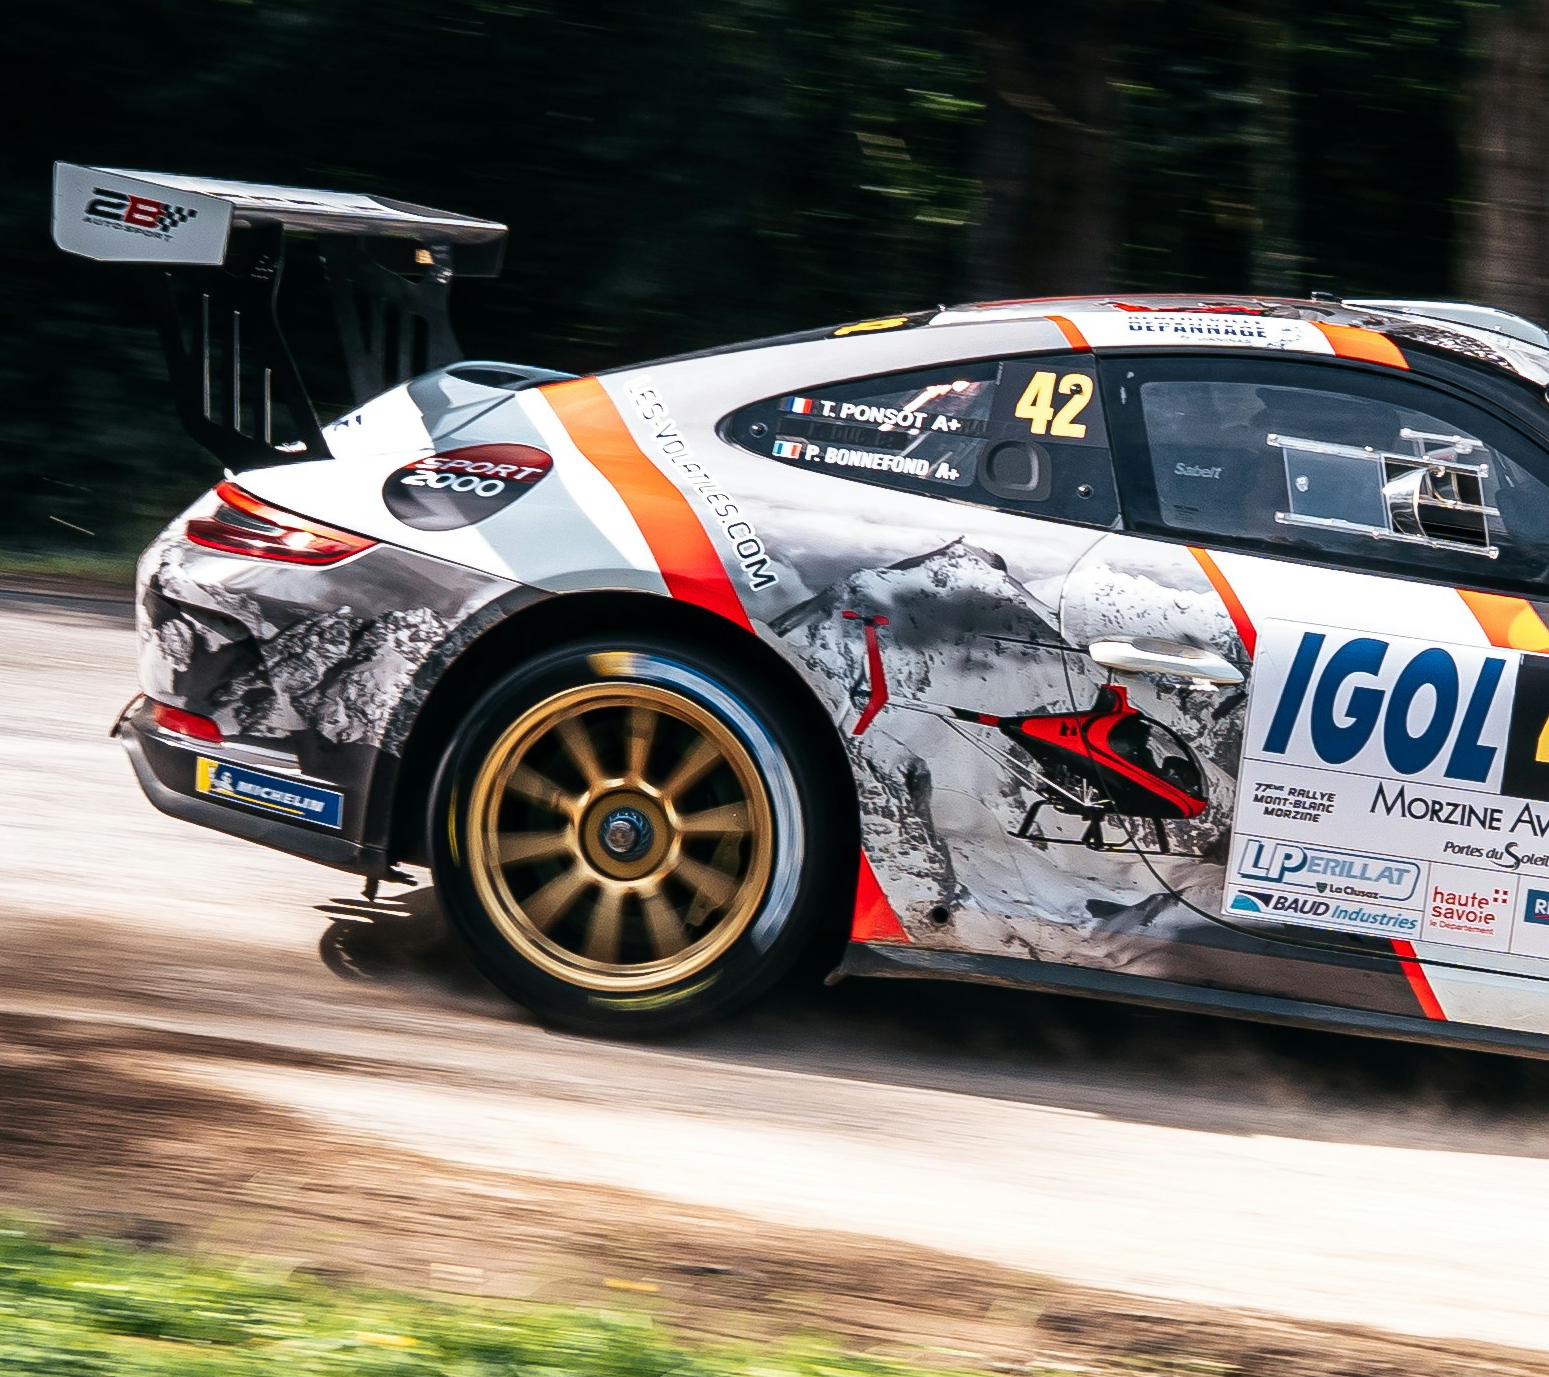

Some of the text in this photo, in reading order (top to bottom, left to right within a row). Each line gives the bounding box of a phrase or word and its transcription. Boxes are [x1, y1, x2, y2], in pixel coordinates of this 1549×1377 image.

[820, 400, 962, 431] T. PONSOT A+
[1014, 371, 1094, 439] 42
[414, 457, 544, 480] SPORT
[804, 444, 960, 480] P. BONNEFOND A+
[400, 469, 506, 498] 2000
[1262, 631, 1507, 783] IGOL
[235, 780, 326, 813] MICHELIN
[1252, 793, 1335, 814] MONT-BLANC
[1287, 787, 1336, 803] RALLYE
[1369, 781, 1504, 832] MORZINE
[1262, 806, 1322, 823] MORZINE
[1442, 840, 1485, 858] Portes
[1485, 847, 1504, 860] du
[1329, 883, 1379, 900] La Clusaz
[1432, 885, 1490, 909] haute
[1271, 895, 1419, 930] BAUD Industries
[1430, 905, 1496, 925] savoie
